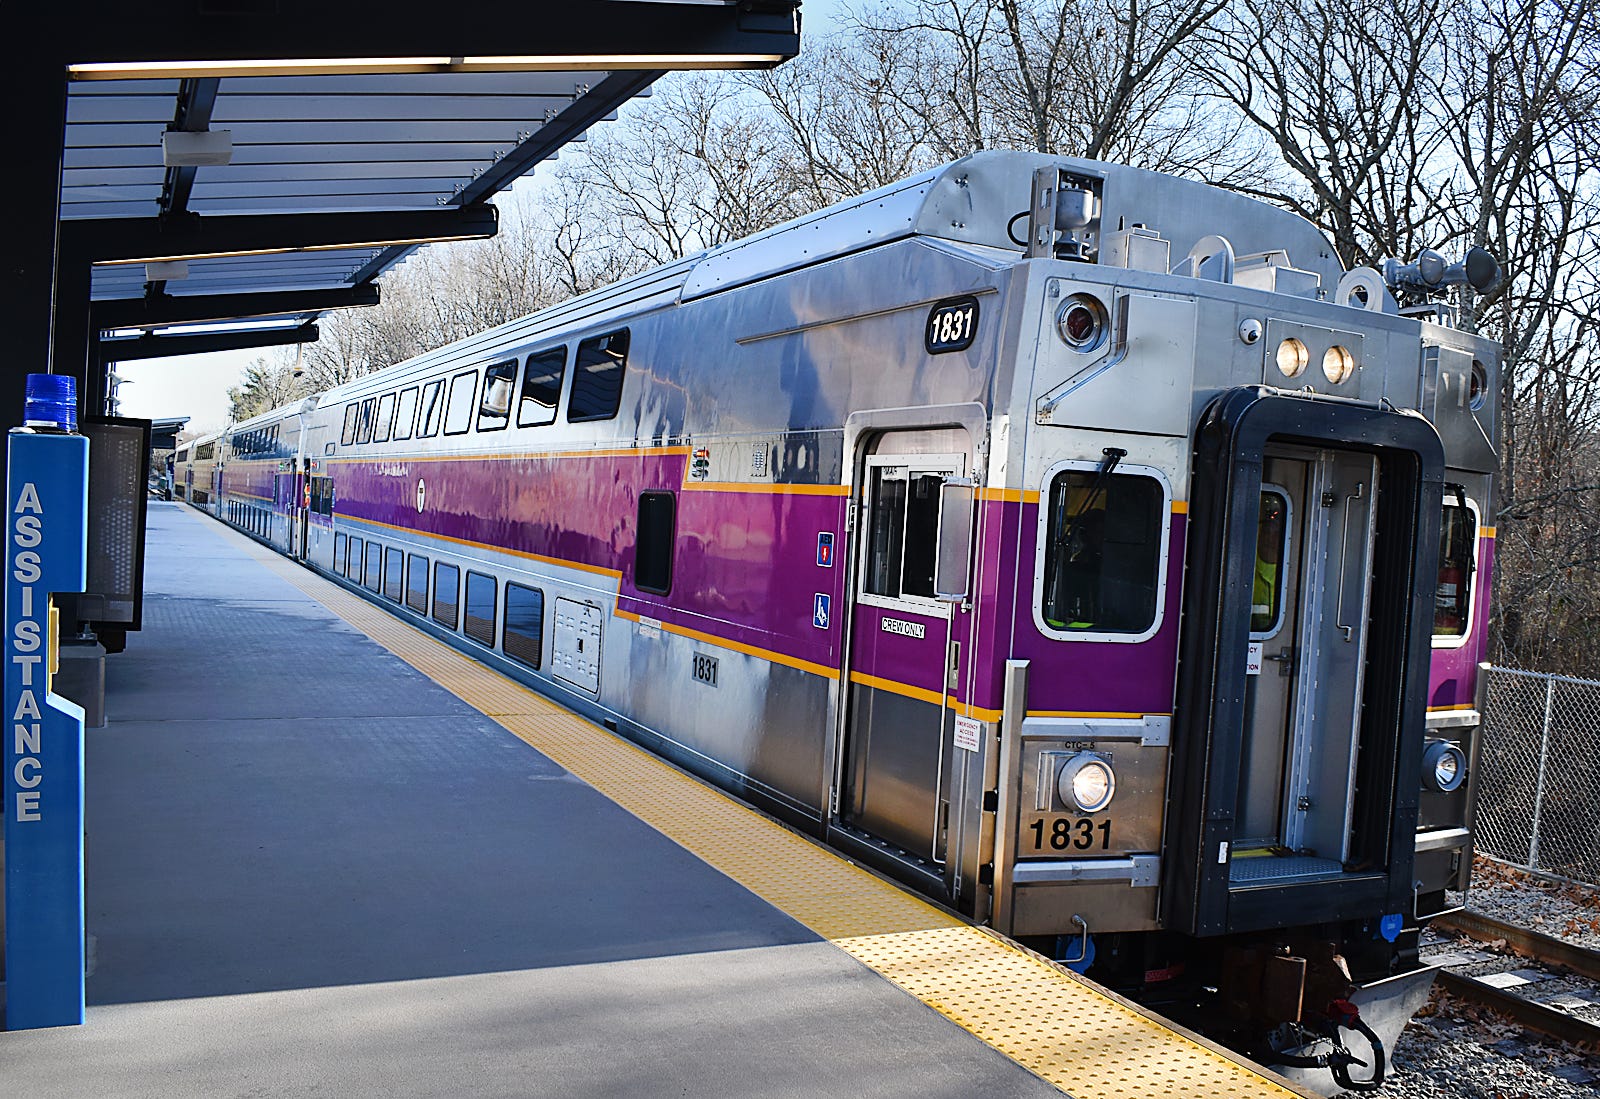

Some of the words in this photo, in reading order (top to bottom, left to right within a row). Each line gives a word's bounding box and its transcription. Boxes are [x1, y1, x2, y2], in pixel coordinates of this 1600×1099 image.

[932, 307, 973, 344] 1831
[882, 618, 904, 633] CREW
[904, 622, 924, 637] ONLY
[13, 482, 43, 822] ASSISTANCE
[693, 655, 717, 684] 1831
[1030, 818, 1112, 850] 1831
